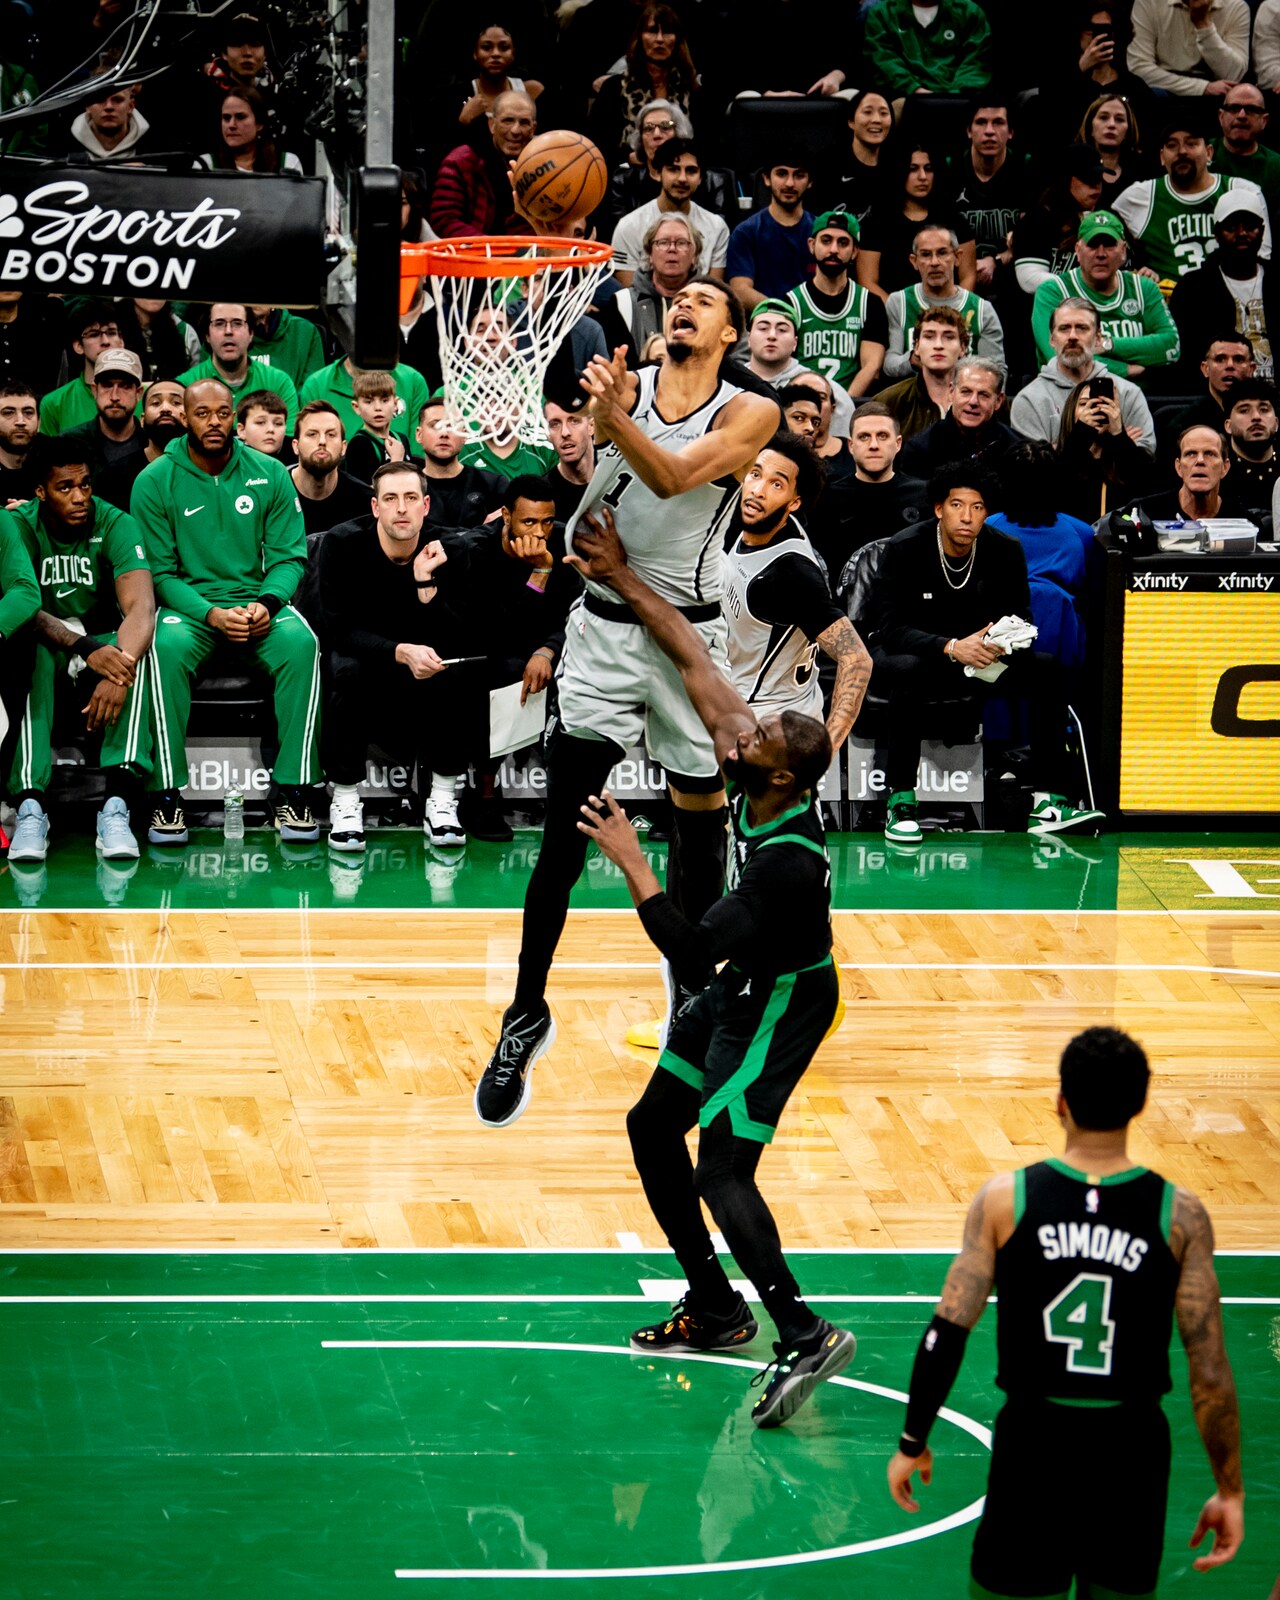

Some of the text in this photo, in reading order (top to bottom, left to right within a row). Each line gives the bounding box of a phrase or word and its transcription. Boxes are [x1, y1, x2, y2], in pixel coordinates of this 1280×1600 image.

[24, 180, 241, 260] Sports
[1168, 213, 1215, 245] CELTIC
[0, 250, 197, 290] BOSTON
[803, 330, 857, 358] BOSTON
[1100, 319, 1143, 338] STON
[601, 471, 635, 511] 1
[1133, 572, 1189, 591] xfinity
[1218, 572, 1275, 591] xfinity
[180, 760, 271, 791] tBlue
[606, 759, 667, 790] tBlu
[857, 761, 969, 798] jelue
[1037, 1221, 1149, 1273] SIMONS
[1042, 1271, 1116, 1376] 4
